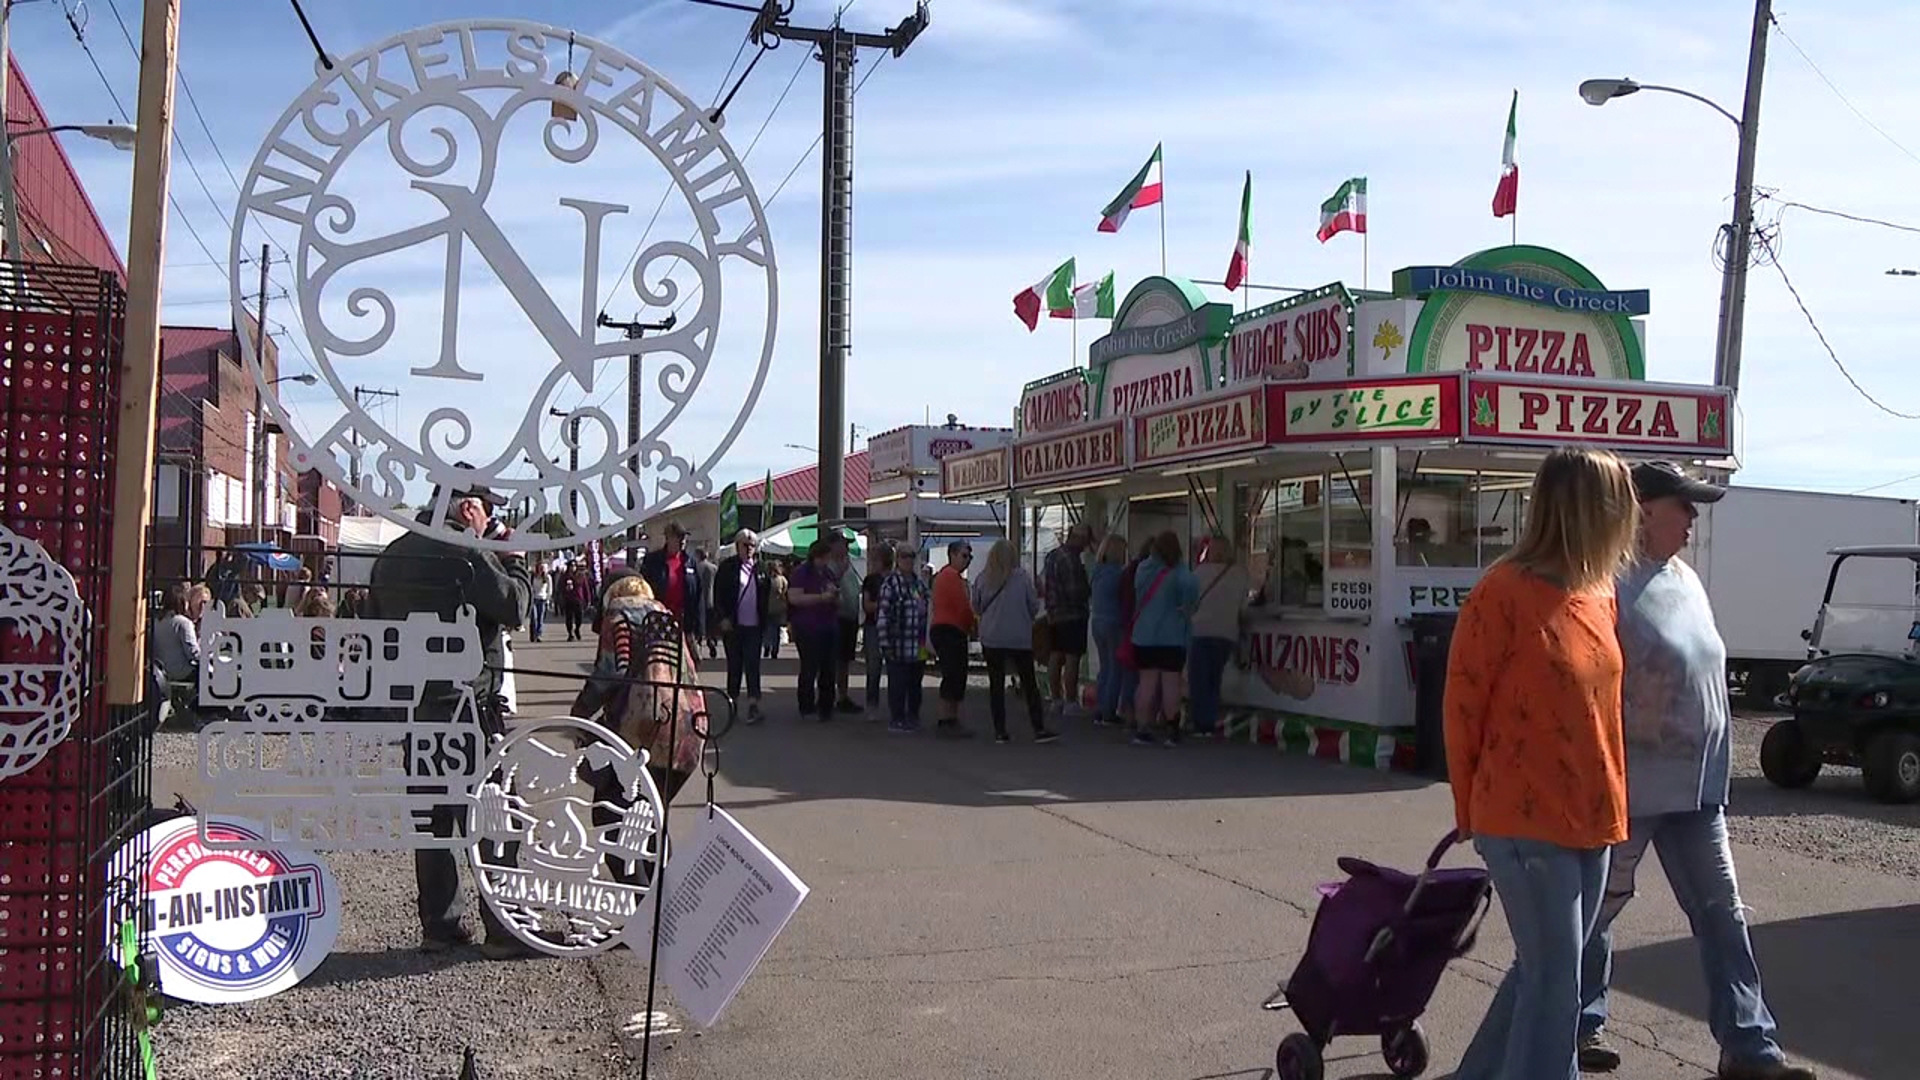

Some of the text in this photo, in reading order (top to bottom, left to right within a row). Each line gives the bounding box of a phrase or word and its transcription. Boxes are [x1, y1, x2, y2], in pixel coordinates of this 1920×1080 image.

[246, 26, 770, 265] NICKELS FAMILY
[1428, 268, 1631, 313] John the Greek
[1130, 330, 1150, 349] the
[1153, 317, 1197, 349] Greek
[1229, 303, 1342, 381] WEDGIE SUBS
[1465, 323, 1595, 378] PIZZA
[1023, 383, 1082, 433] CALZONES
[1112, 366, 1194, 416] PIZZERIA
[1290, 389, 1385, 424] BY THE
[1331, 396, 1435, 428] SLICE
[1518, 391, 1680, 438] PIZZA
[1176, 402, 1246, 449] PIZZA
[1024, 432, 1113, 473] CALZONES
[516, 438, 691, 537] 2003
[1409, 586, 1471, 607] FRE
[1248, 632, 1360, 684] ALZONES
[134, 876, 312, 932] N-AN-INSTANT
[176, 924, 292, 974] SIGNS & MORE
